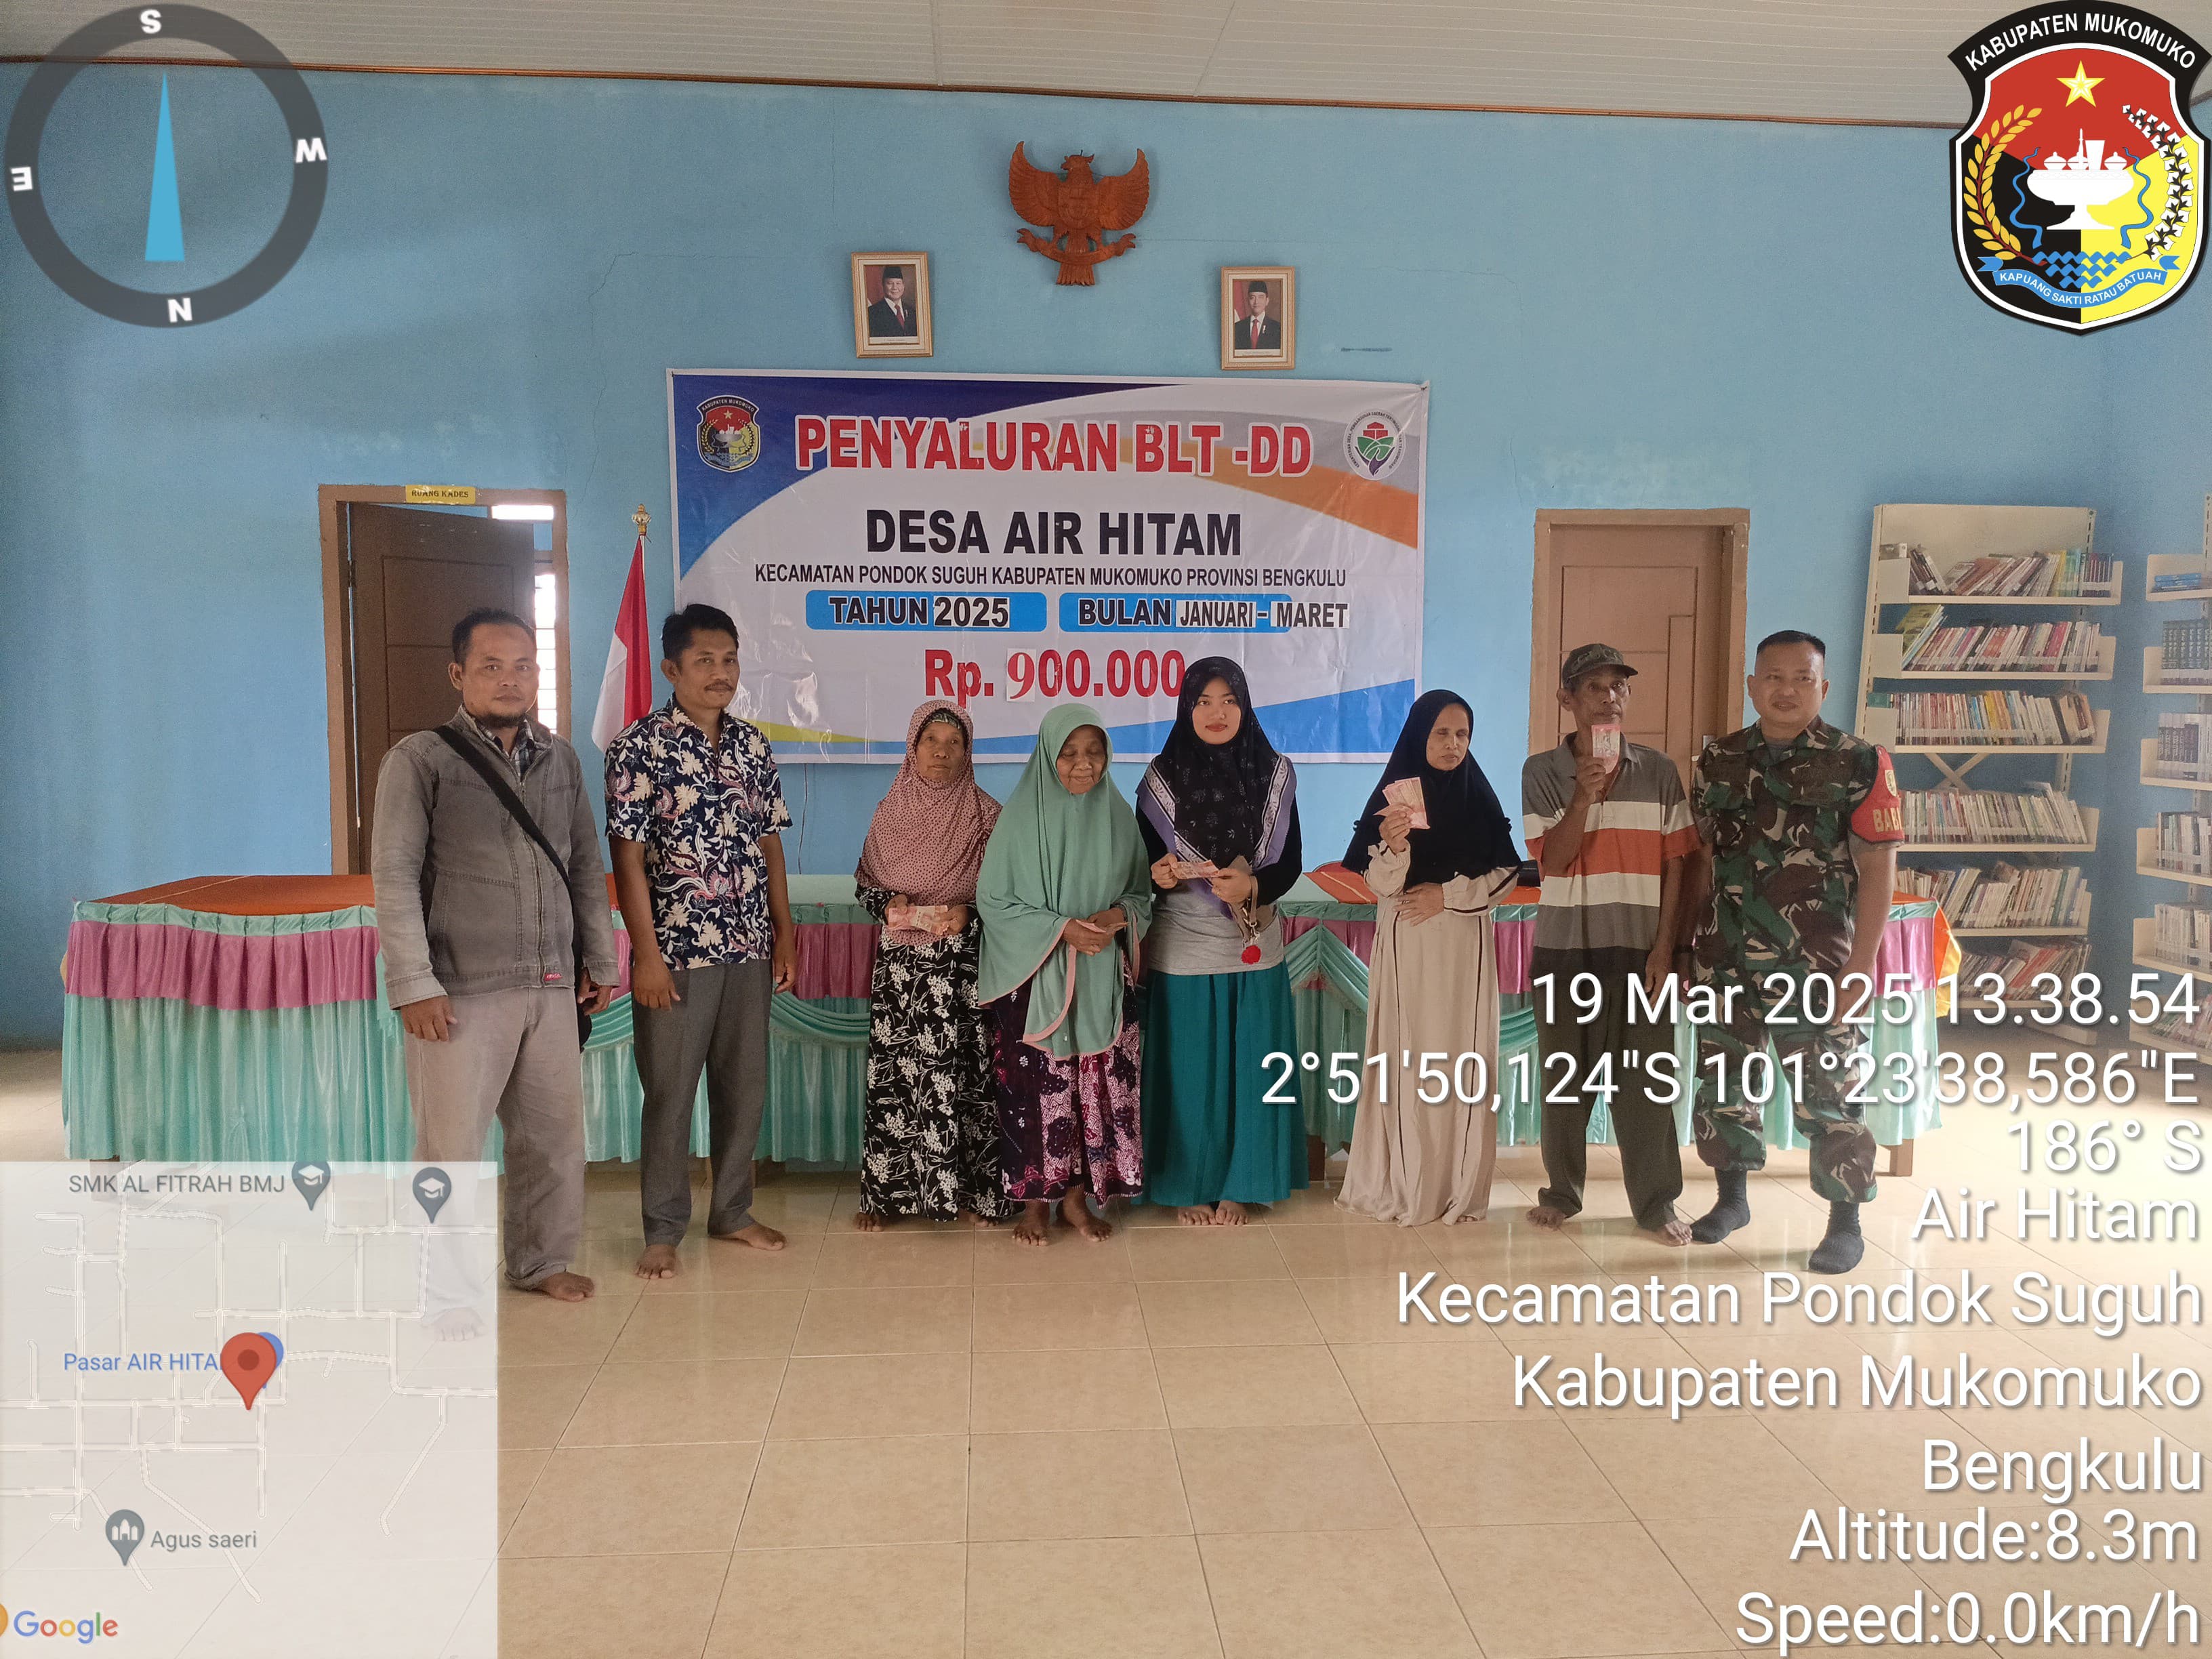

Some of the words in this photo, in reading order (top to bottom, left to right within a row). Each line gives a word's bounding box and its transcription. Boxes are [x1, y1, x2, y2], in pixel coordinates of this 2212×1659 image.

[798, 417, 1118, 472] PENYALURAN
[1135, 424, 1221, 473] BLT
[1235, 425, 1311, 474] -DD
[867, 509, 990, 554] DESA
[1003, 511, 1084, 554] AIR
[1099, 512, 1241, 556] HITAM
[755, 564, 854, 583] KECAMATAN
[859, 565, 927, 583] PONDOK
[932, 567, 987, 584] SUGUH
[992, 567, 1085, 586] KABUPATEN
[1090, 568, 1182, 586] MUKOMUKO
[1187, 569, 1258, 587] PROVINSI
[1263, 569, 1347, 587] BENGKULU
[829, 596, 928, 625] TAHUN
[934, 597, 1009, 627] 2025
[1078, 599, 1171, 627] BULAN
[1180, 601, 1254, 628] JANUARI
[1277, 602, 1349, 628] MARET
[924, 649, 994, 709] Rp.
[1006, 649, 1186, 700] 900.000
